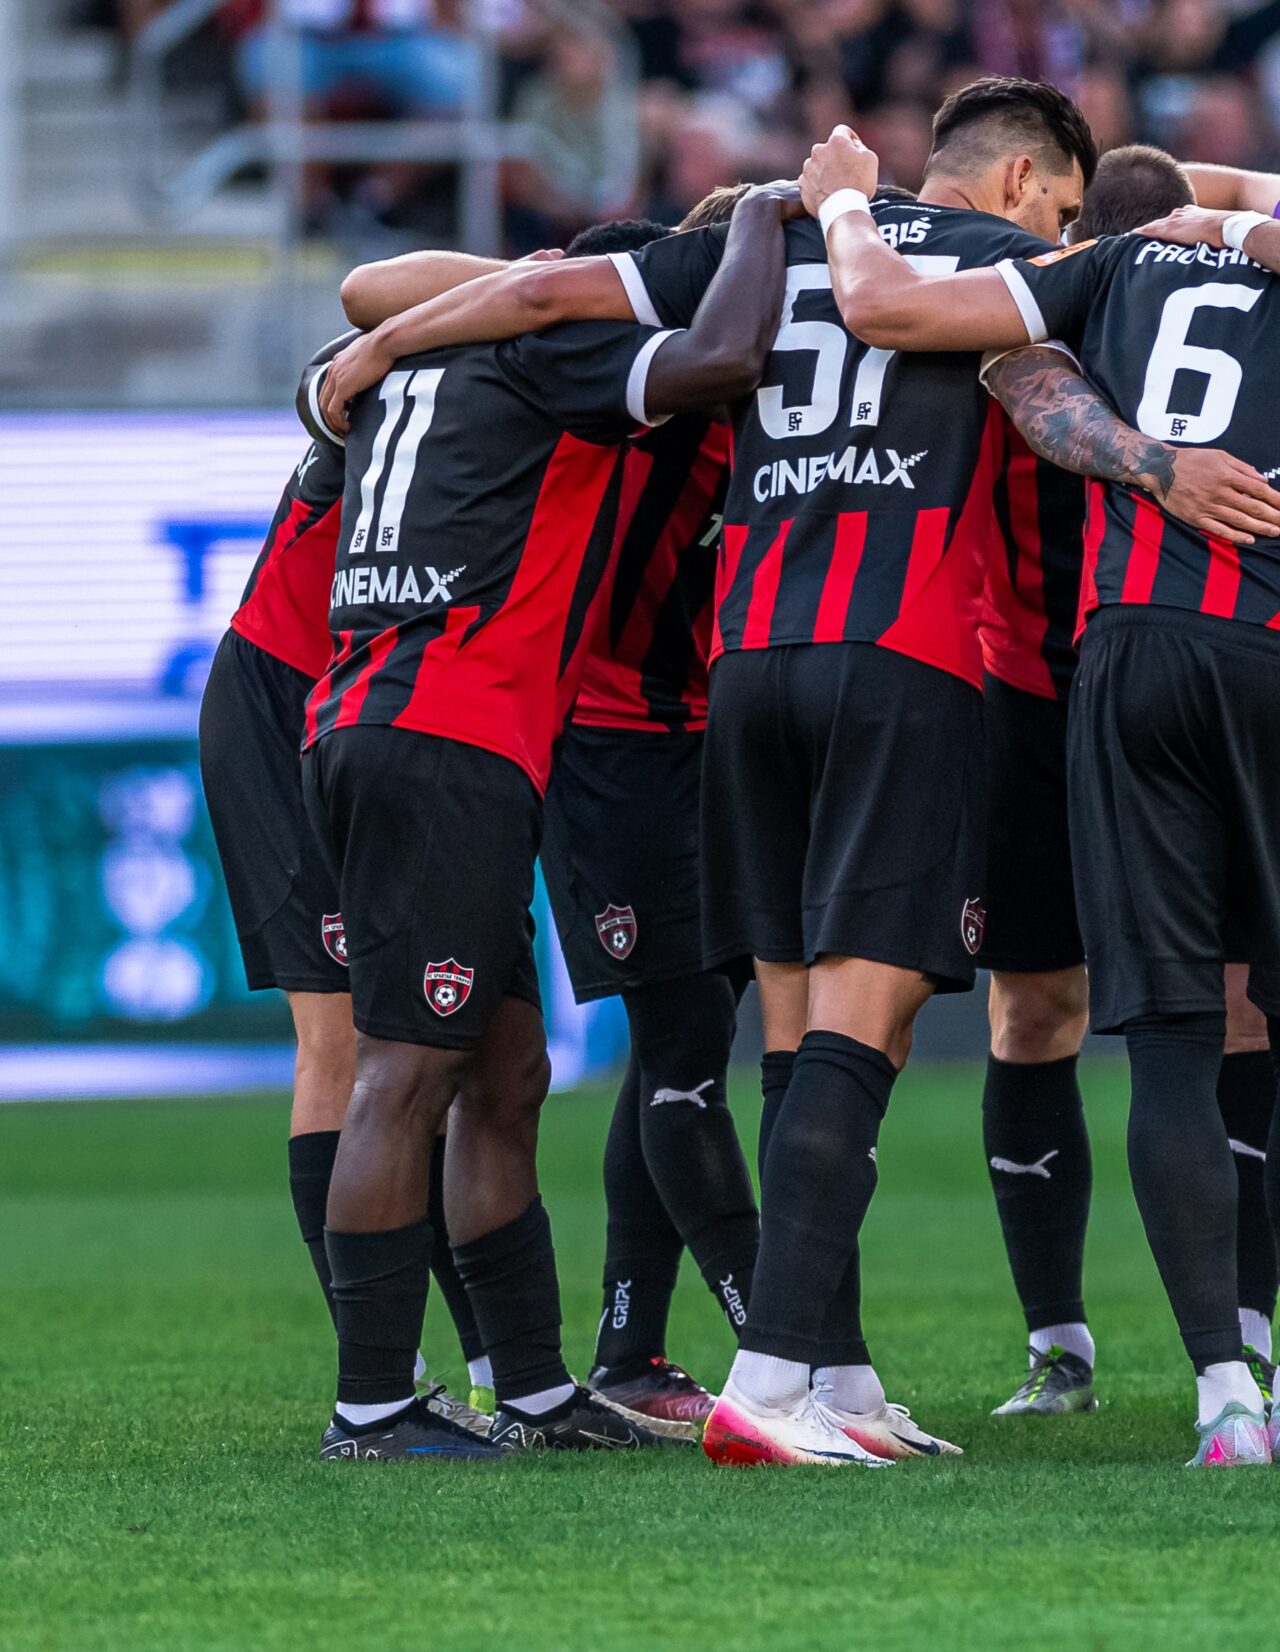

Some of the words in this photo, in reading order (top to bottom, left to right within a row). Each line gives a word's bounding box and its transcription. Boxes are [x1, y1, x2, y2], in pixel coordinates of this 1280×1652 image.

[1136, 282, 1265, 443] 6
[349, 368, 446, 553] 11
[753, 446, 928, 502] CINEMAX
